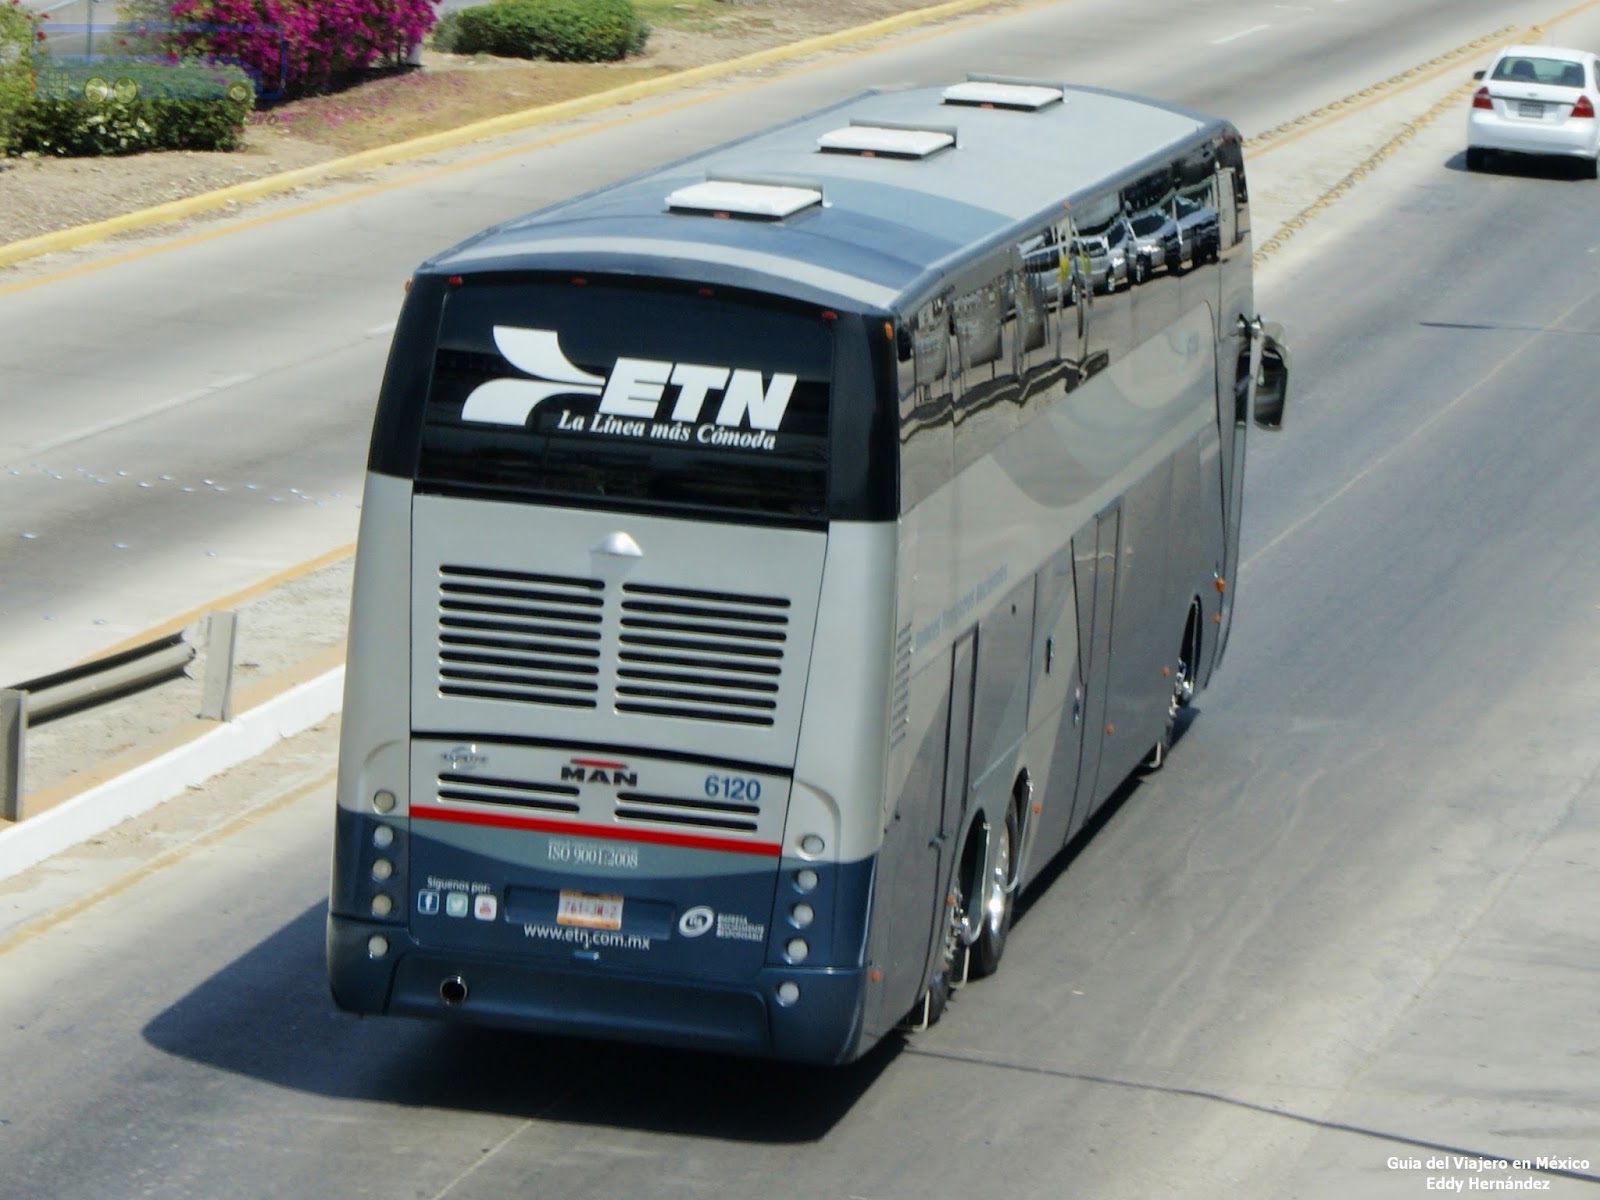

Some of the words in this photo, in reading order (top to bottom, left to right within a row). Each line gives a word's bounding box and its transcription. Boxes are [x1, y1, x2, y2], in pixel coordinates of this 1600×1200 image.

[599, 357, 797, 430] ETN
[558, 410, 585, 431] La
[589, 413, 645, 437] Línea
[650, 422, 691, 442] más
[697, 424, 776, 450] Cómoda
[560, 766, 638, 787] MAN
[705, 775, 761, 801] 6120
[548, 842, 570, 862] ISO
